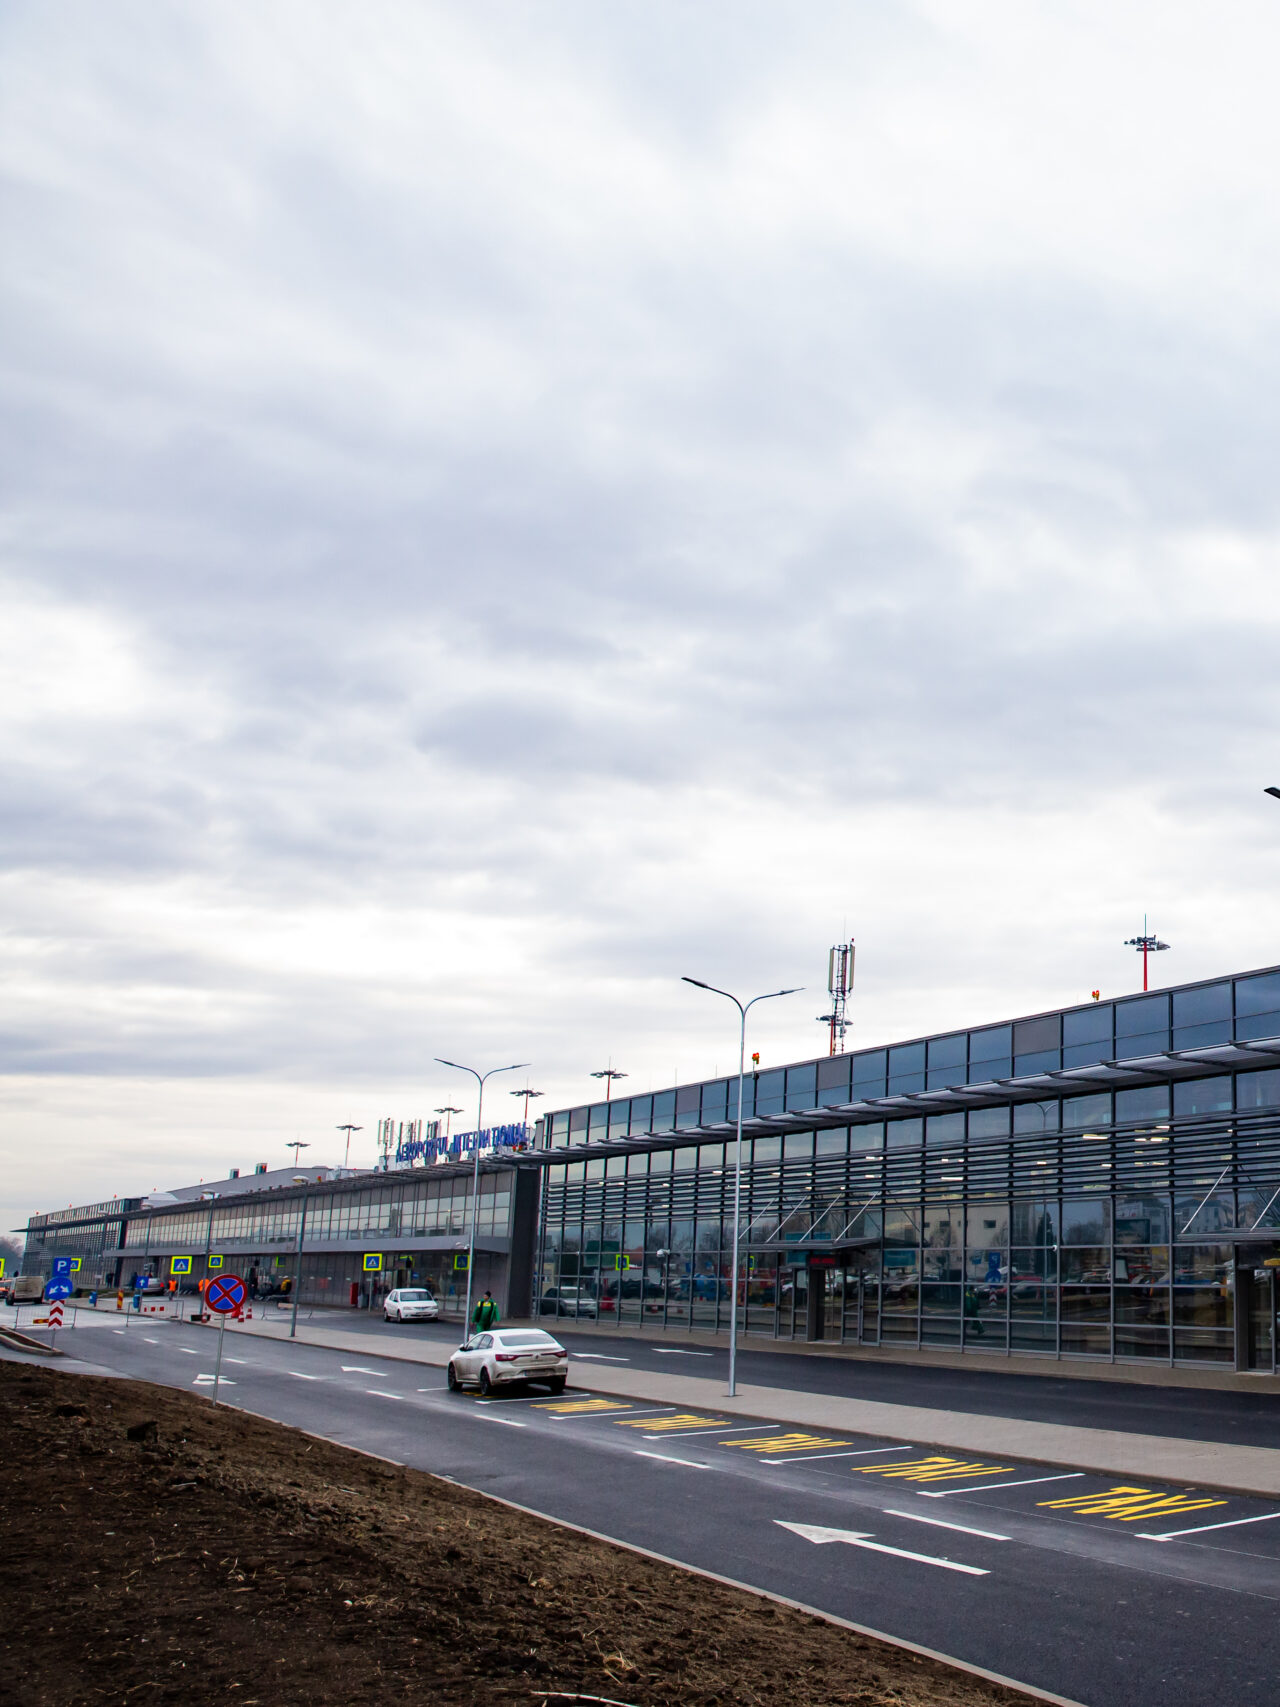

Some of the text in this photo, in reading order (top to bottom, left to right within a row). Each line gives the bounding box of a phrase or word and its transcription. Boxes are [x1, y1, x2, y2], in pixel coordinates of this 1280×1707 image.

[57, 1260, 67, 1272] P
[851, 1456, 1013, 1482] TAXI
[1036, 1486, 1228, 1521] TAXI
